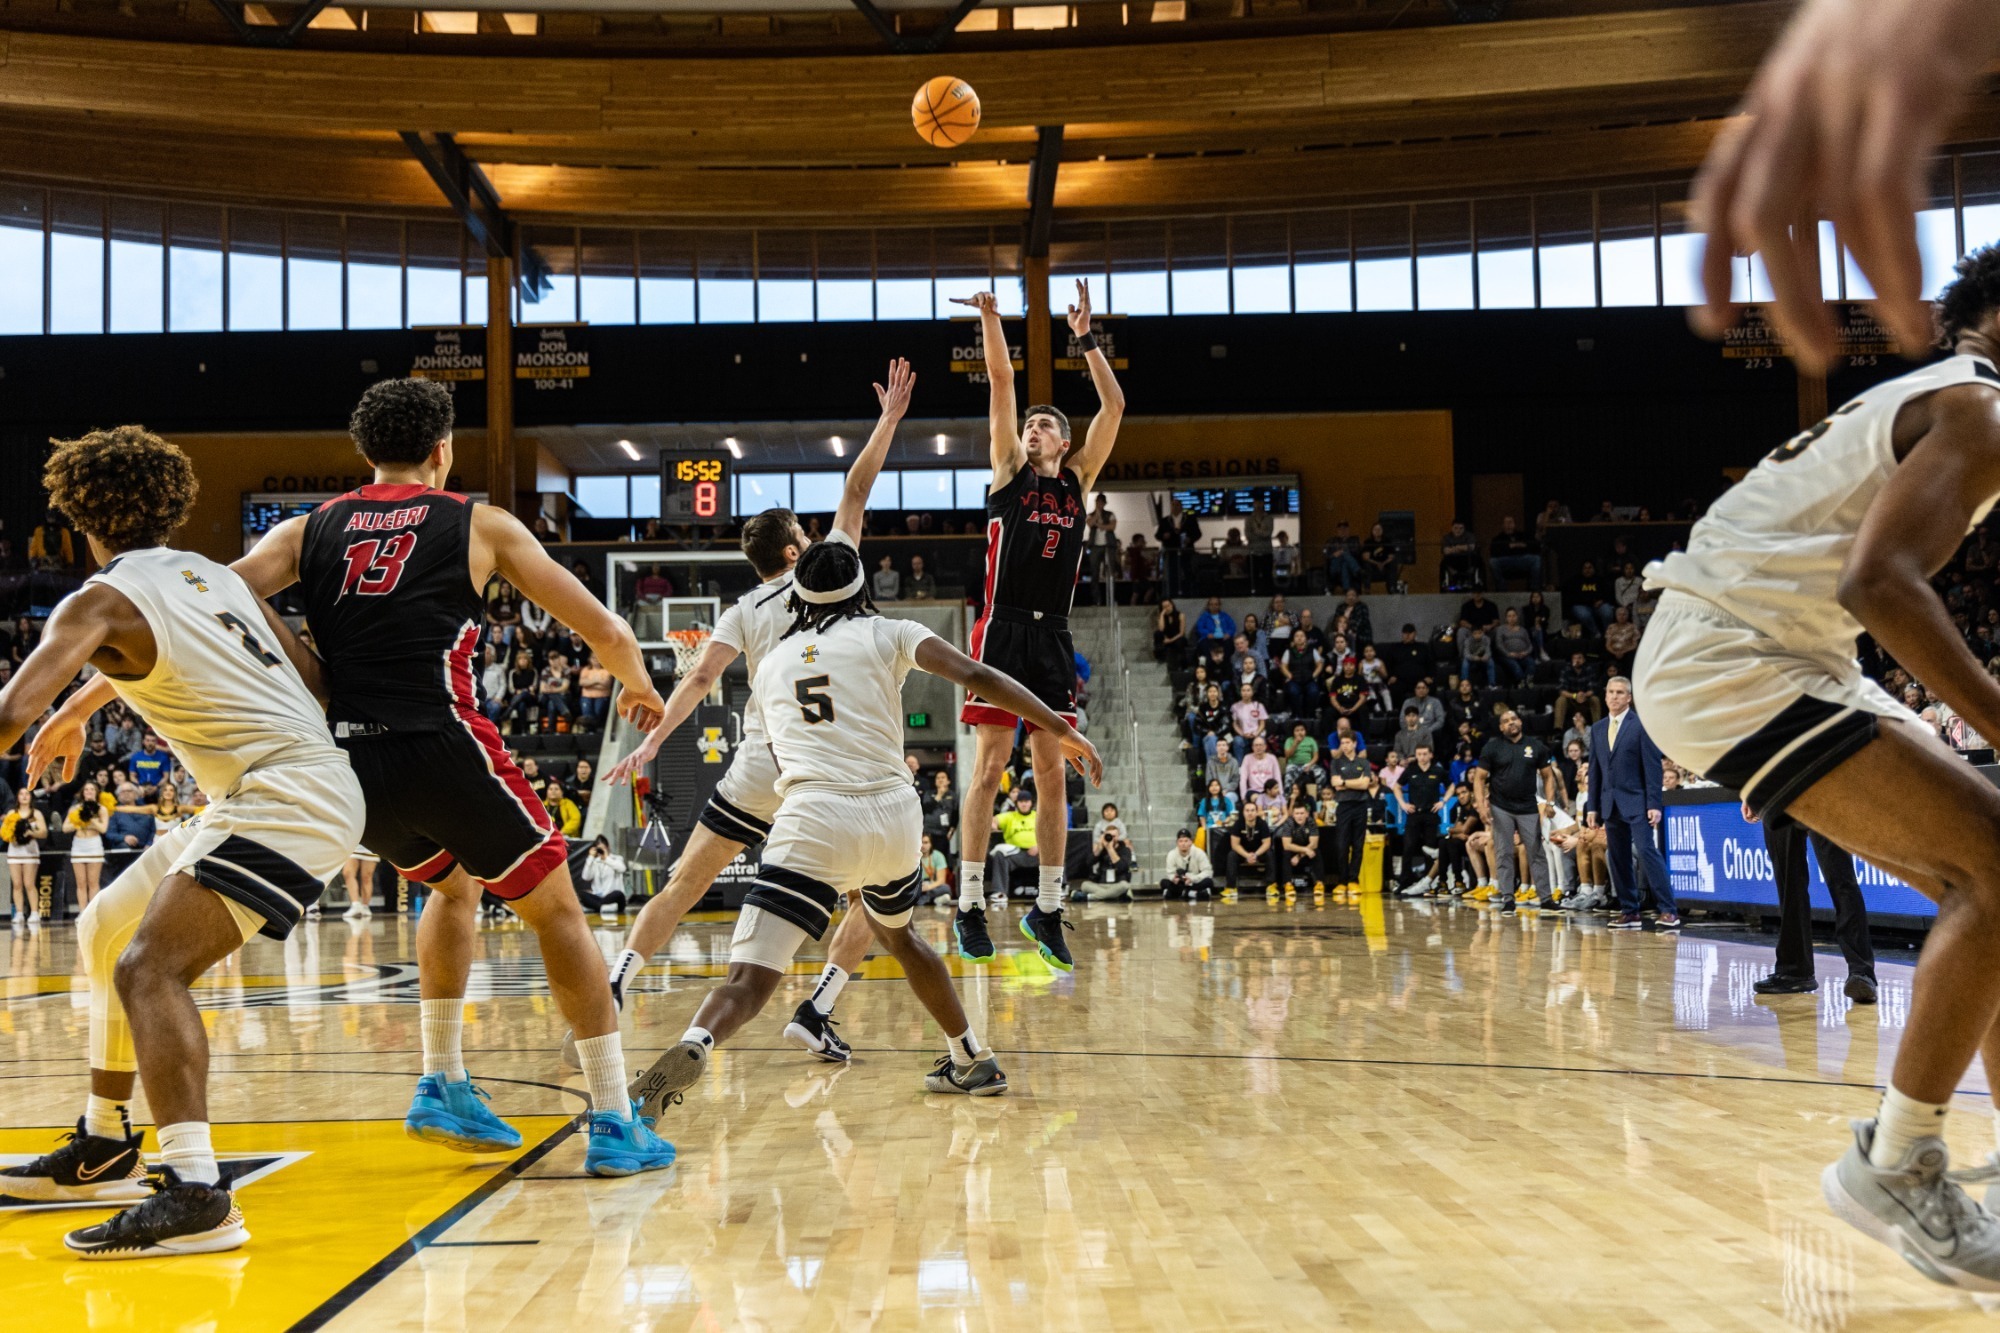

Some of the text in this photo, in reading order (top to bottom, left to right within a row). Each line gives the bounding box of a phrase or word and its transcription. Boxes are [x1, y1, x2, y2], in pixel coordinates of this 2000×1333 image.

[1723, 327, 1770, 340] SWEET
[1834, 326, 1896, 337] HAMPIONS
[434, 343, 461, 355] GUS
[538, 341, 568, 352] DON
[412, 355, 483, 369] JOHNSON
[517, 352, 589, 366] MONSON
[1745, 358, 1773, 369] 27-3
[1850, 355, 1878, 366] 26-5
[534, 379, 574, 390] 100-41
[677, 460, 722, 481] 15:52
[1104, 458, 1280, 480] ONCESSIONS
[263, 476, 463, 493] CONCES
[695, 482, 717, 517] 8
[344, 505, 429, 532] ALLEGRI
[1042, 529, 1061, 559] 2
[334, 531, 417, 605] 13
[213, 611, 283, 669] 2
[794, 673, 836, 726] 5
[1667, 816, 1696, 851] IDAHO
[719, 862, 759, 875] entral
[1722, 837, 1774, 881] Choos
[39, 875, 53, 918] NOISE
